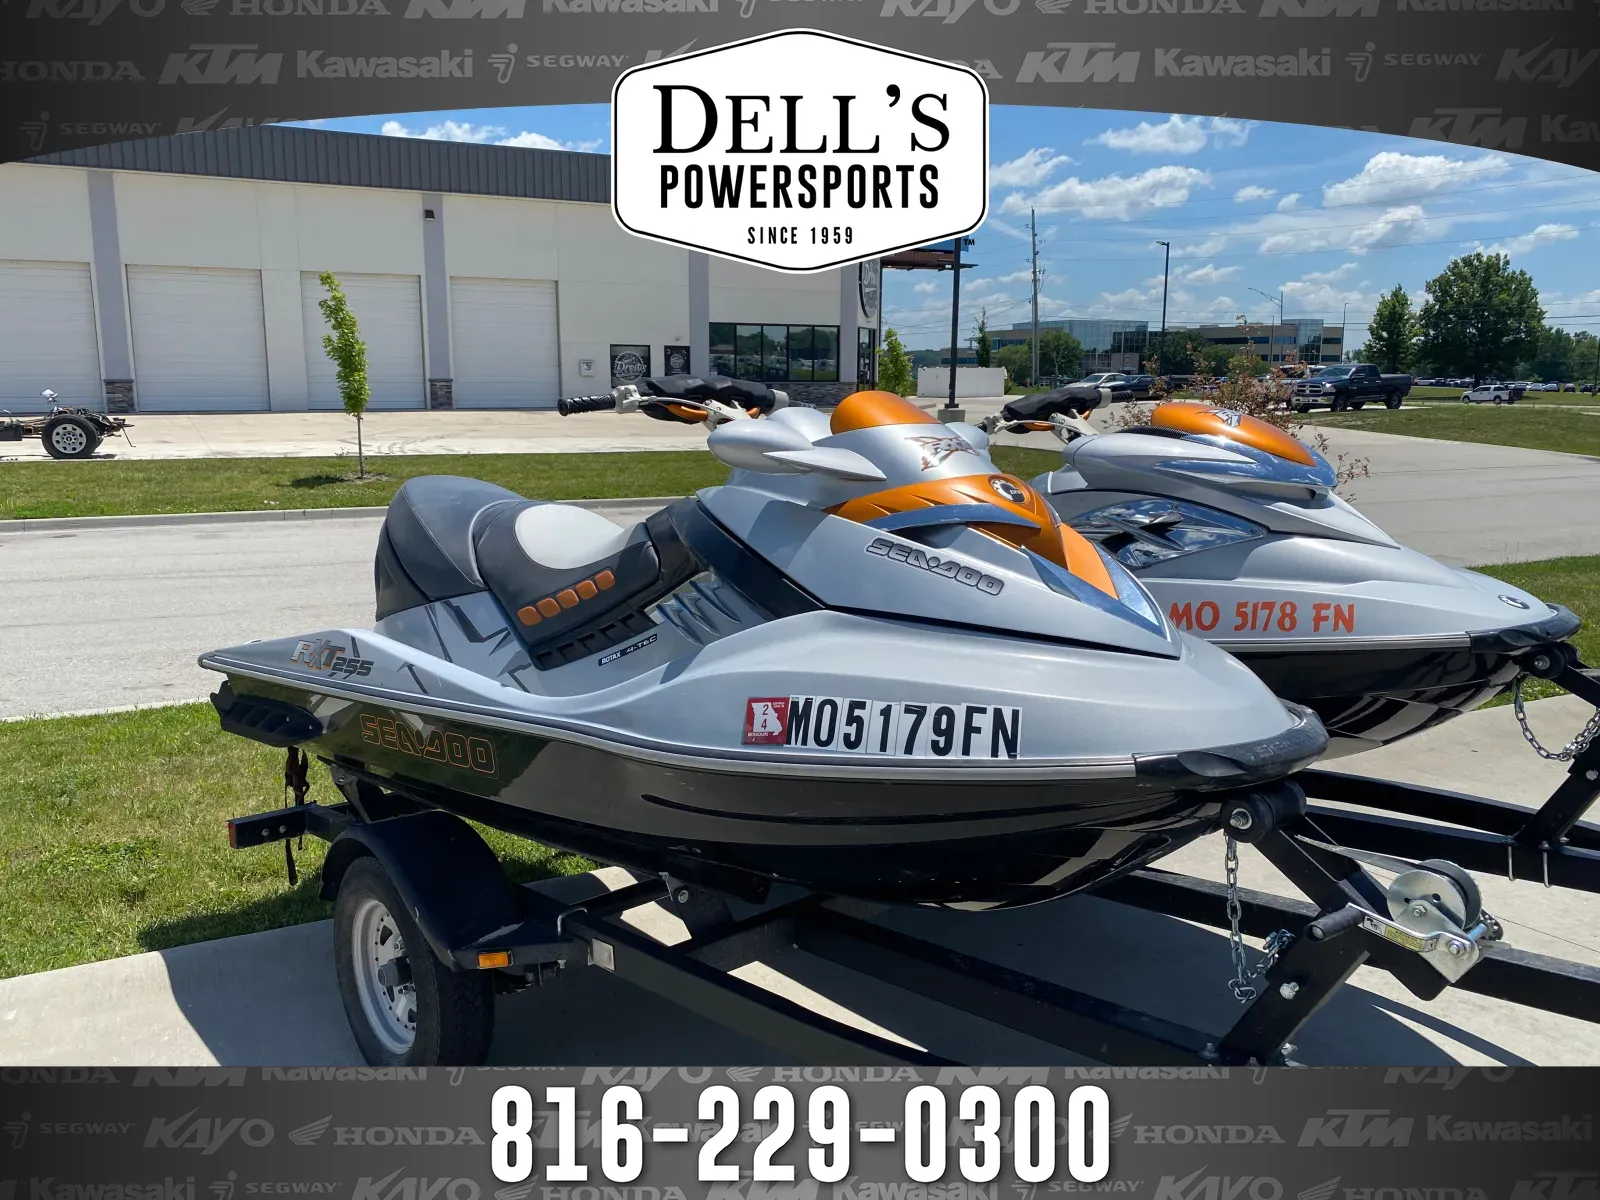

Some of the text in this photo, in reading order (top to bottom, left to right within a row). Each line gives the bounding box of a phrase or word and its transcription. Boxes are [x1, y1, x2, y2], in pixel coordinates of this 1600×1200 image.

[1169, 601, 1355, 633] MO 5178 FN
[330, 656, 375, 678] 255
[762, 703, 769, 716] 2
[761, 718, 768, 730] 4
[786, 696, 1021, 760] MO5179FN
